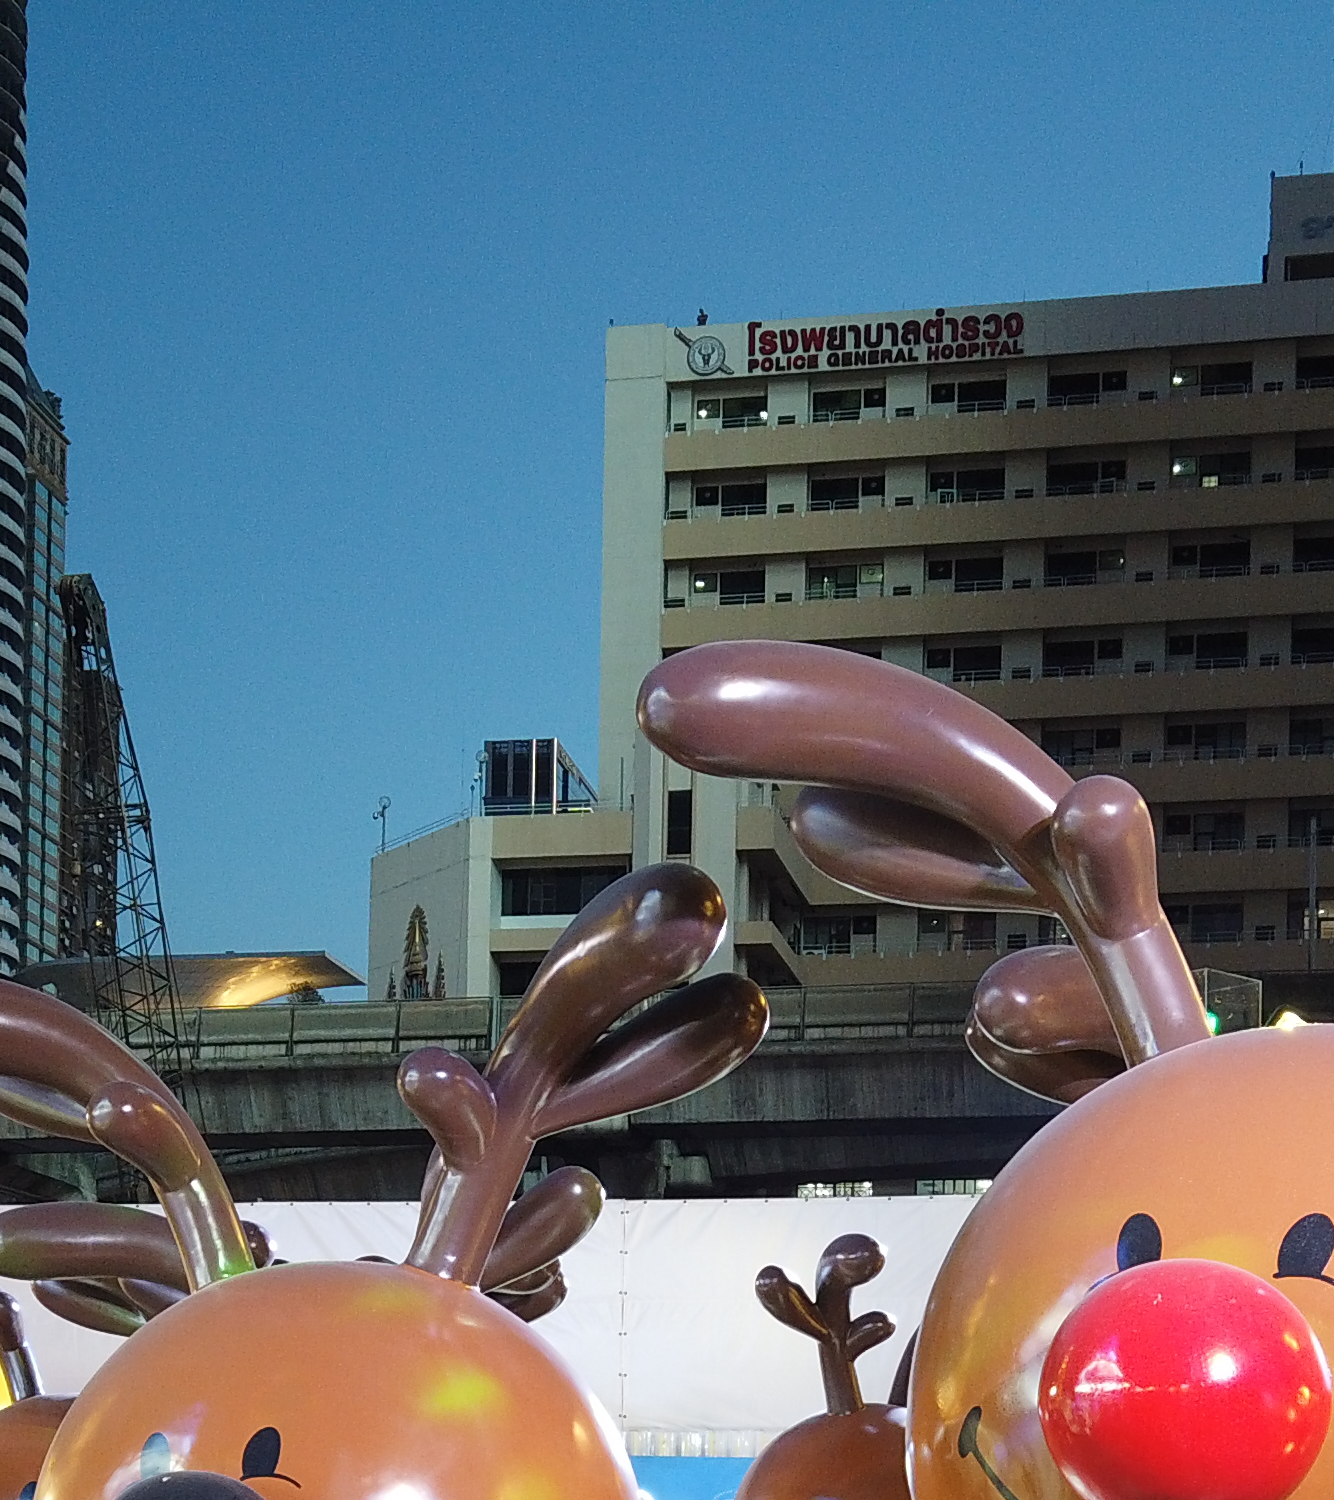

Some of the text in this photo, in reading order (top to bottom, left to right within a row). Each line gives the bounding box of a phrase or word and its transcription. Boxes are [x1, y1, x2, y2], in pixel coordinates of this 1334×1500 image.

[748, 339, 1024, 373] POLICE GENERAL HOSPITAL
